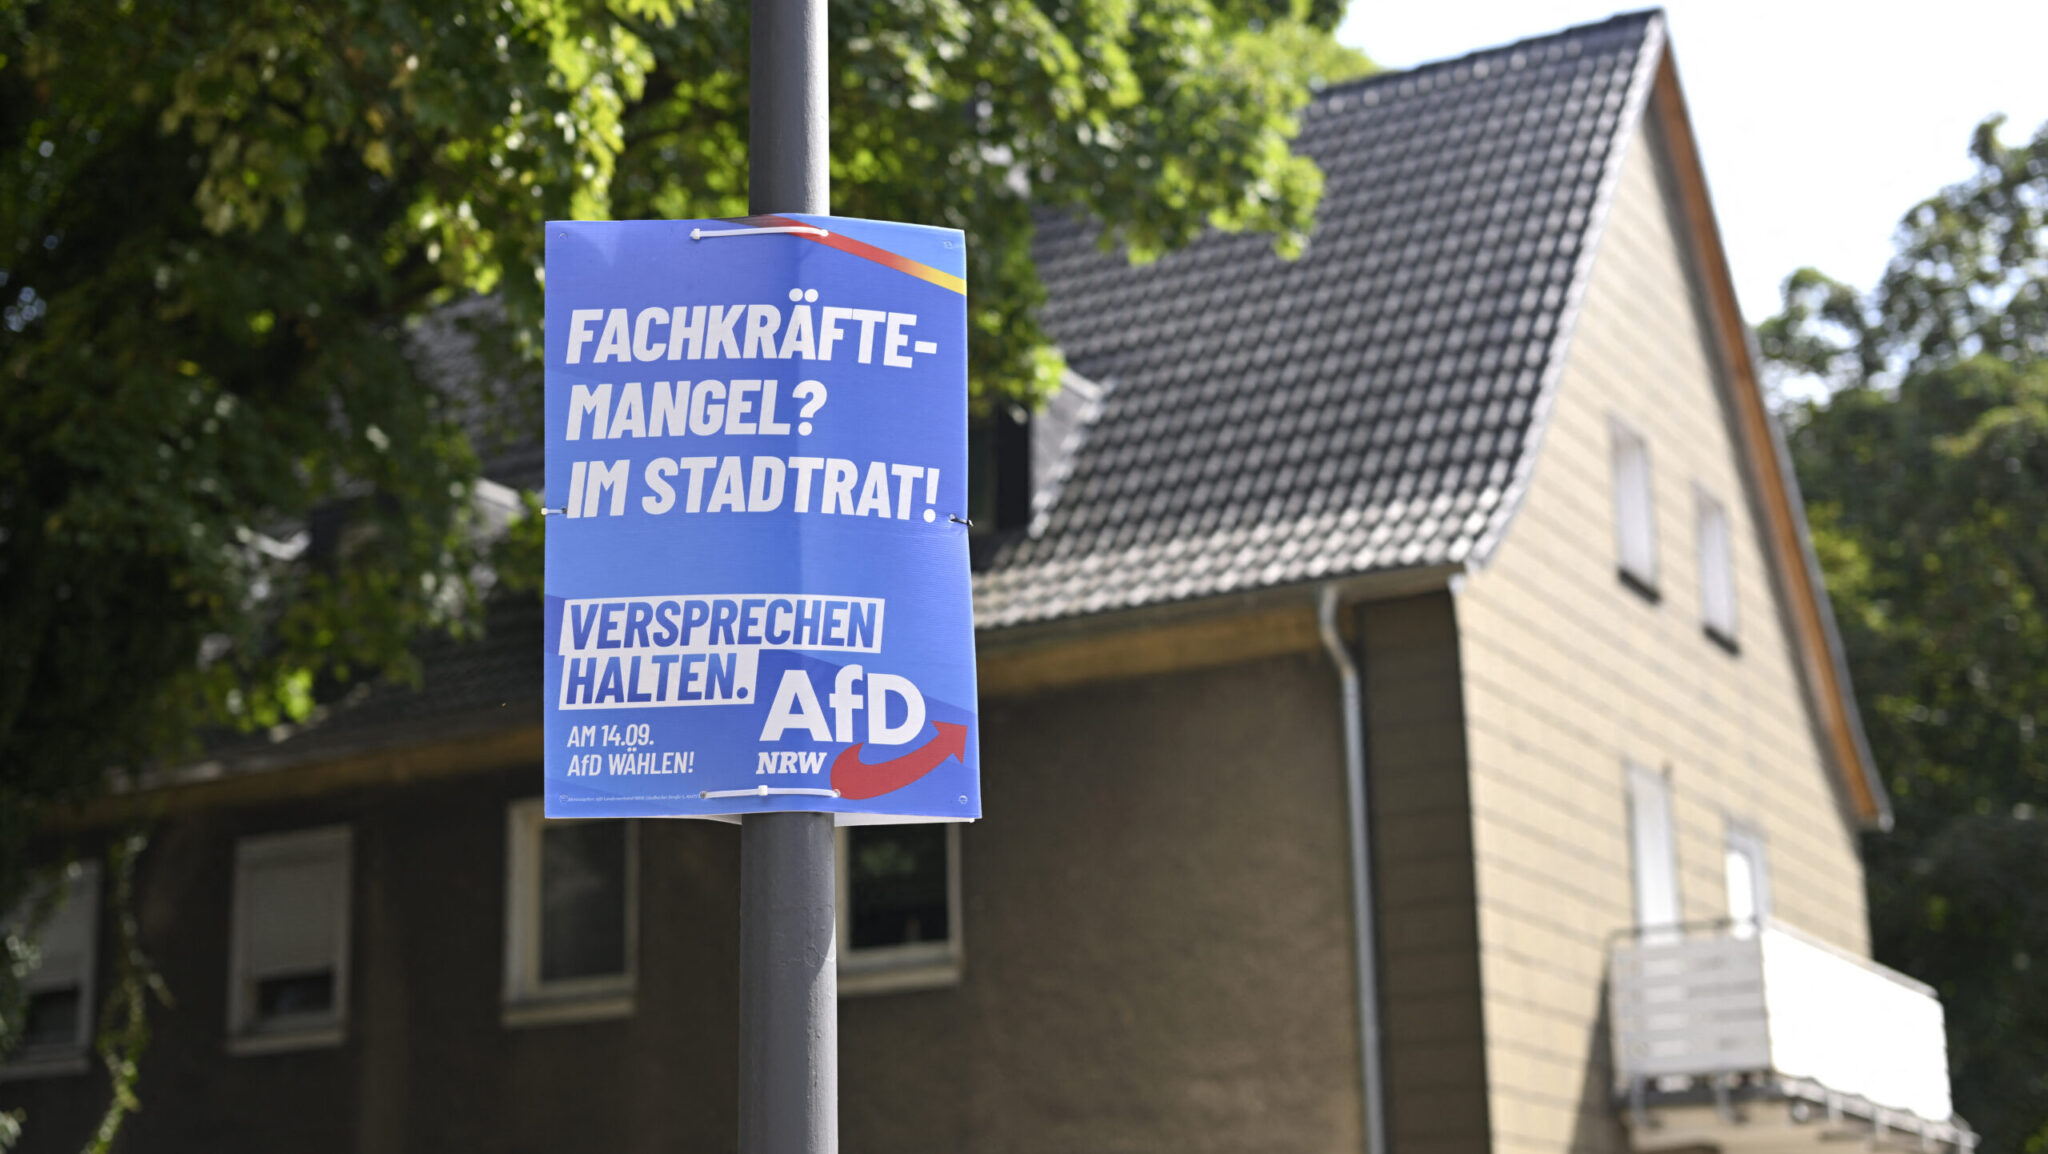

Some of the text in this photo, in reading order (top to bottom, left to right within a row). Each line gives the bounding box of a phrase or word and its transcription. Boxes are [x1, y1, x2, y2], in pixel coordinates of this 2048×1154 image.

[566, 288, 937, 368] FACHKRÄFTE-
[566, 380, 827, 440] MANGEL?
[567, 455, 940, 522] IM STADTRAT!
[571, 598, 877, 650] VERSPRECHEN
[566, 653, 748, 705] HALTEN.
[759, 664, 926, 746] AfD
[567, 724, 654, 747] AM 14.09.
[567, 748, 694, 776] AfD WÄHLEN!
[756, 752, 827, 775] NRW
